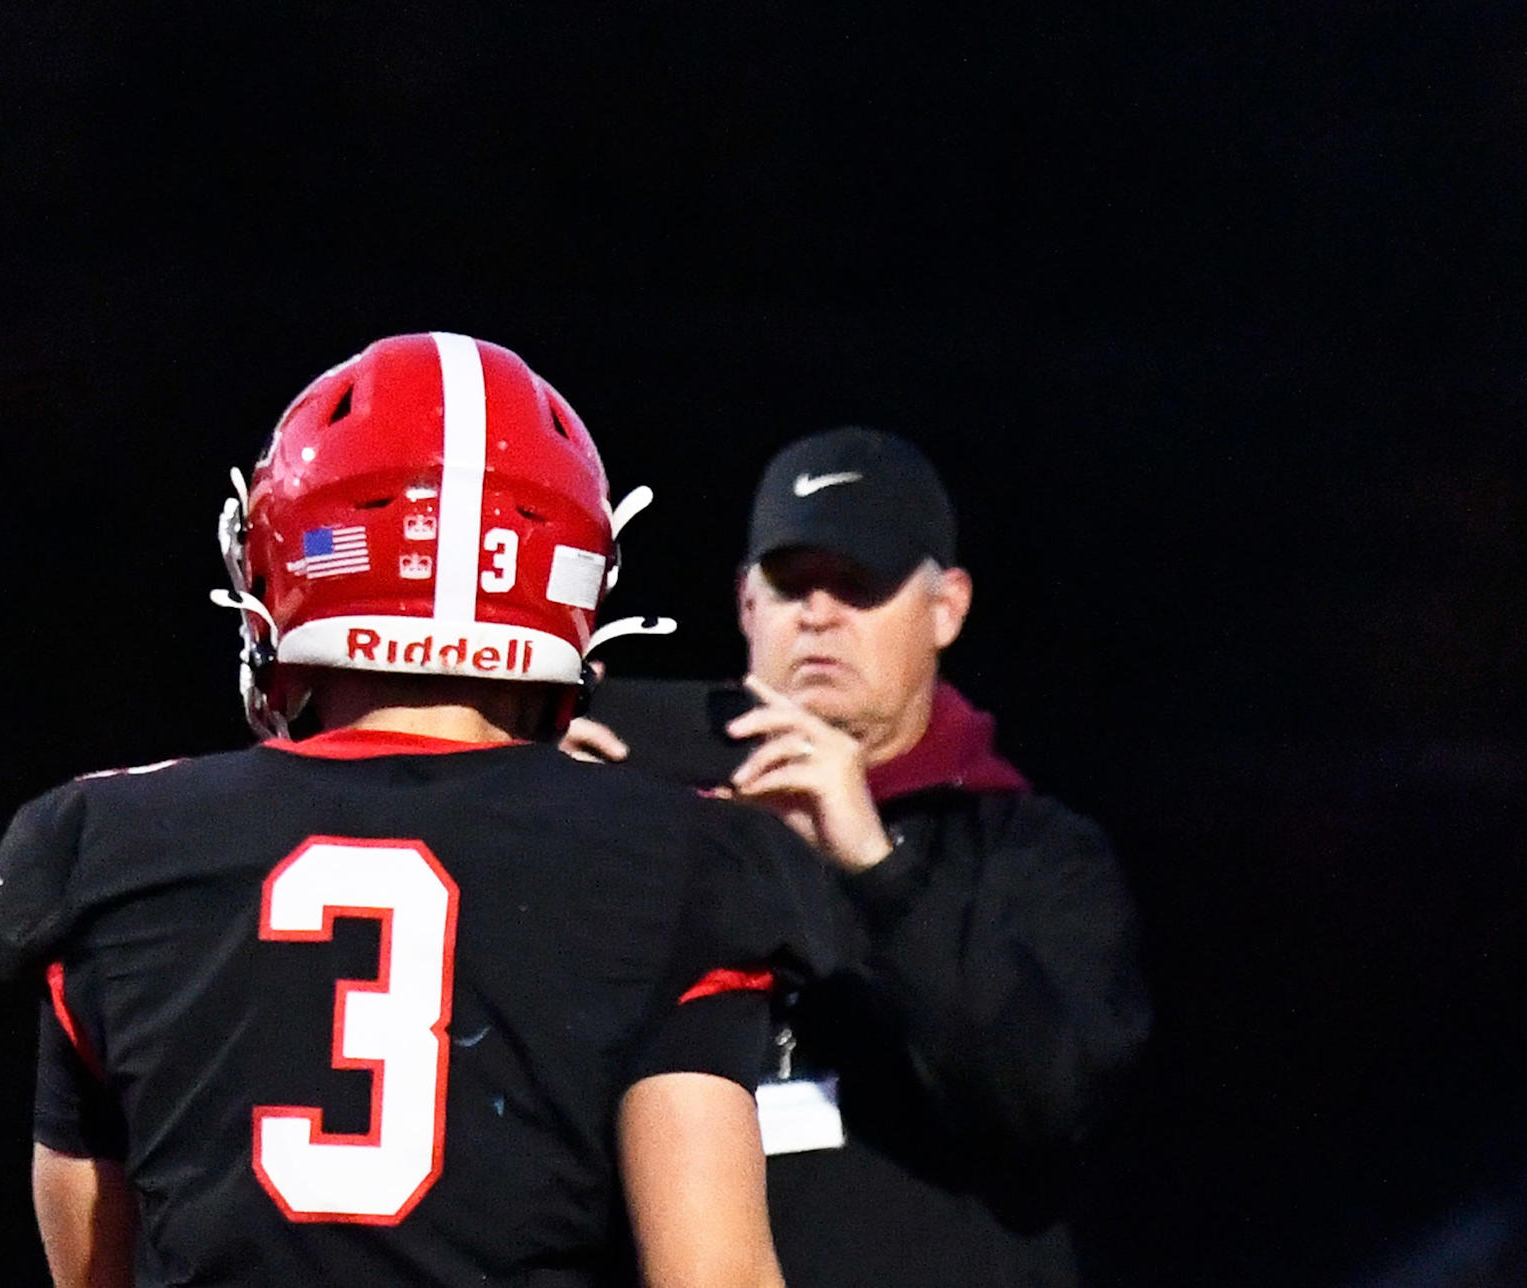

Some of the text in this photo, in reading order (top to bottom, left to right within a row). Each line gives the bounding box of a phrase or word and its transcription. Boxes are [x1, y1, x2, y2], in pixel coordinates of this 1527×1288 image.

[480, 528, 519, 593] 3
[346, 627, 534, 674] Riddell
[252, 835, 460, 1227] 3
